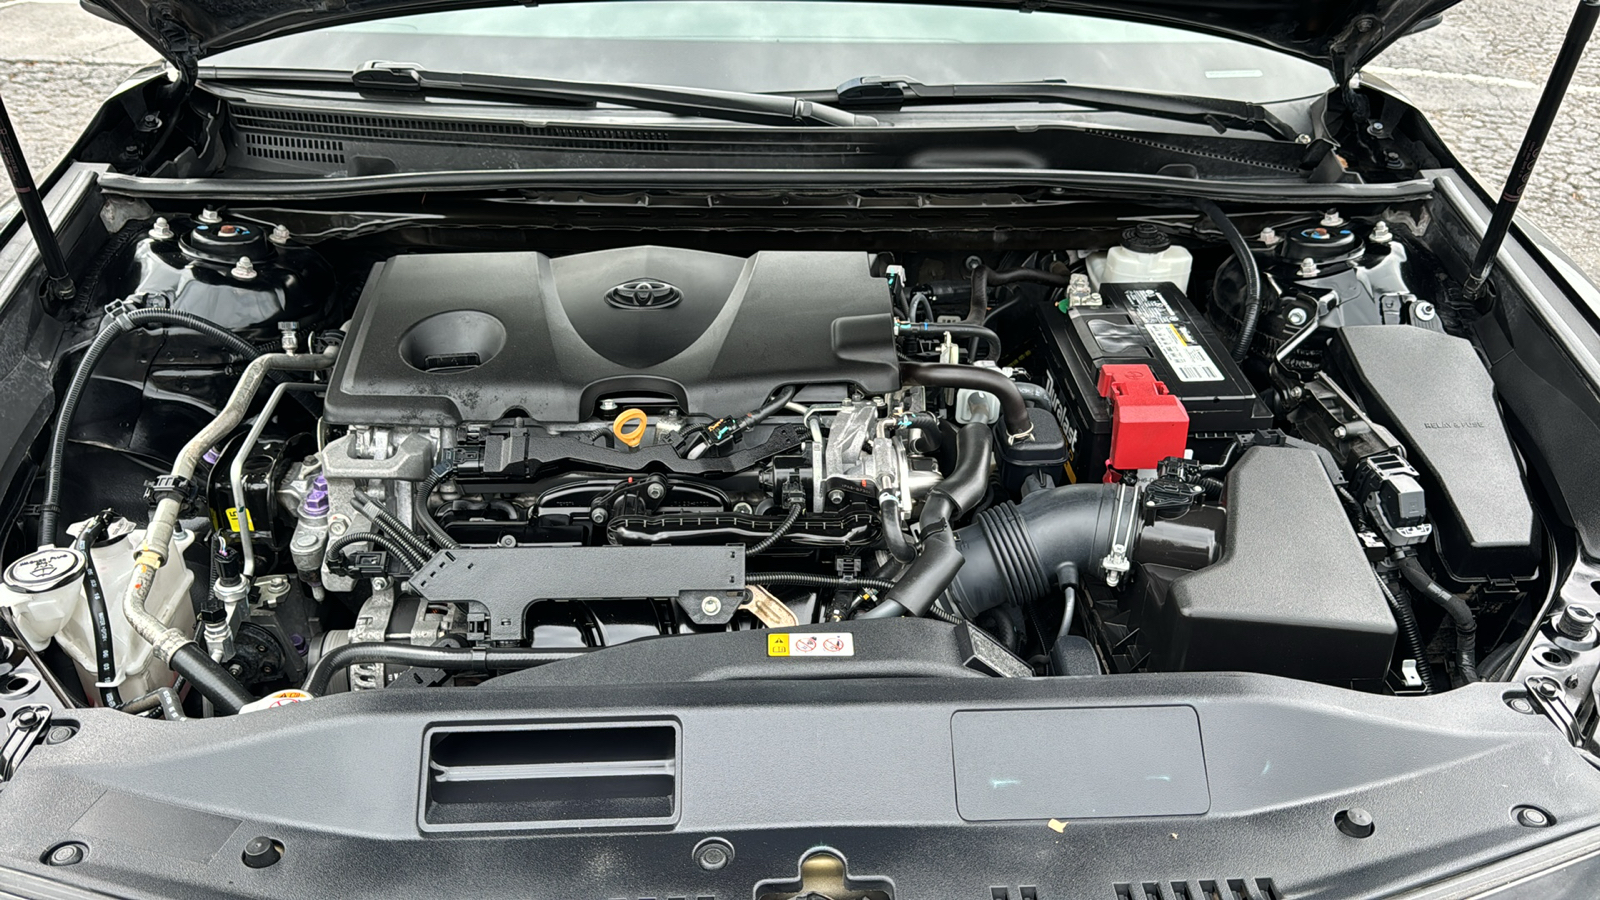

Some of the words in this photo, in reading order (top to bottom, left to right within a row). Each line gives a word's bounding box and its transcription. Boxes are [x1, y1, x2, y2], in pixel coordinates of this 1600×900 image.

[1045, 368, 1078, 453] Duralast
[1423, 421, 1452, 429] RELAY
[1461, 421, 1485, 429] FUSE
